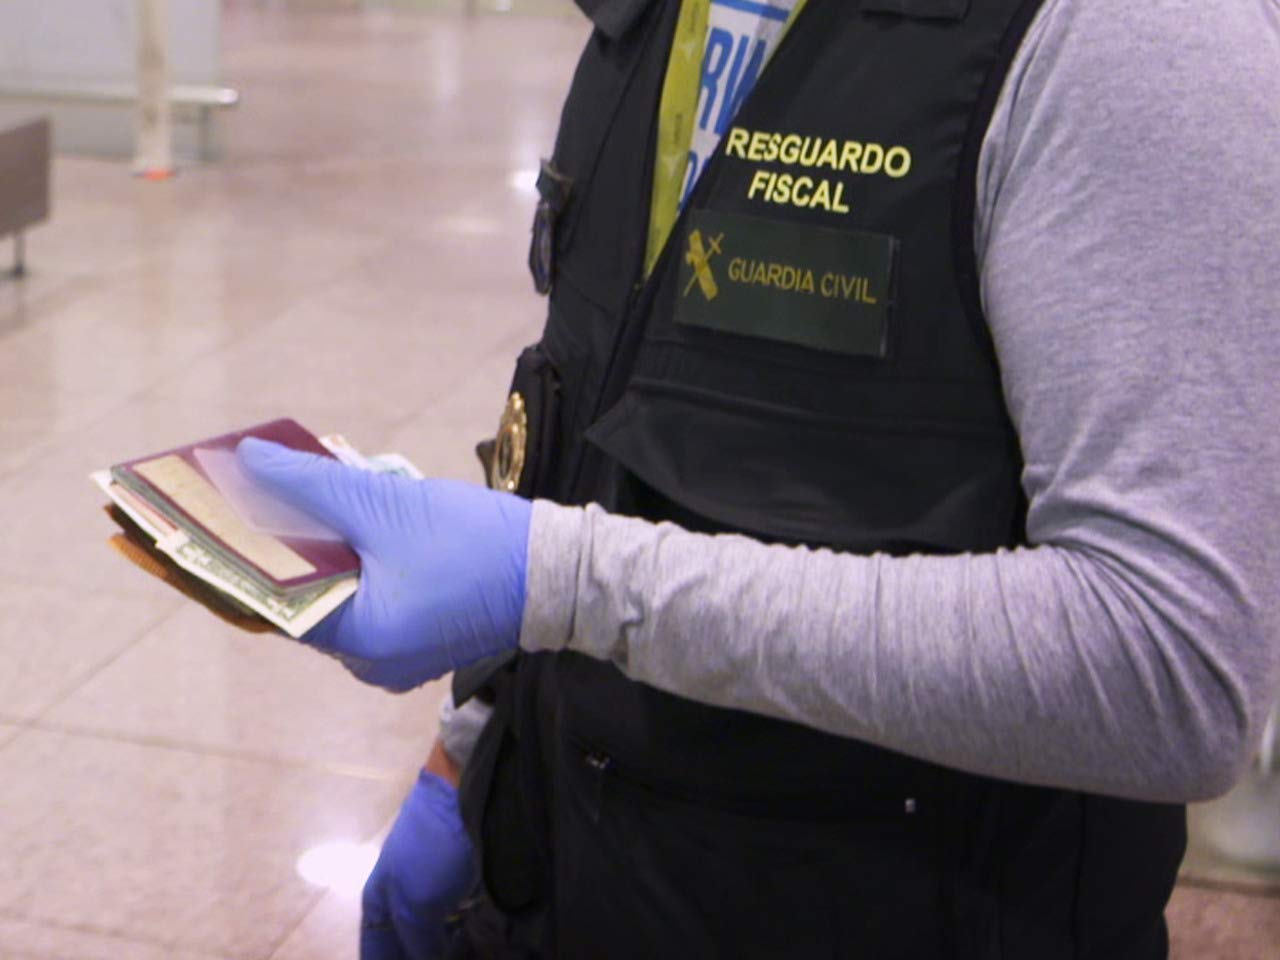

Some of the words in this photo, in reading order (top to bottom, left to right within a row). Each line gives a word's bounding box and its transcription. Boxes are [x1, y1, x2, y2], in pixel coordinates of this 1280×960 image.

[725, 126, 912, 178] RESGUARDO
[747, 169, 850, 213] FISCAL
[728, 257, 815, 294] GUARDIA
[821, 273, 877, 304] CIVIL
